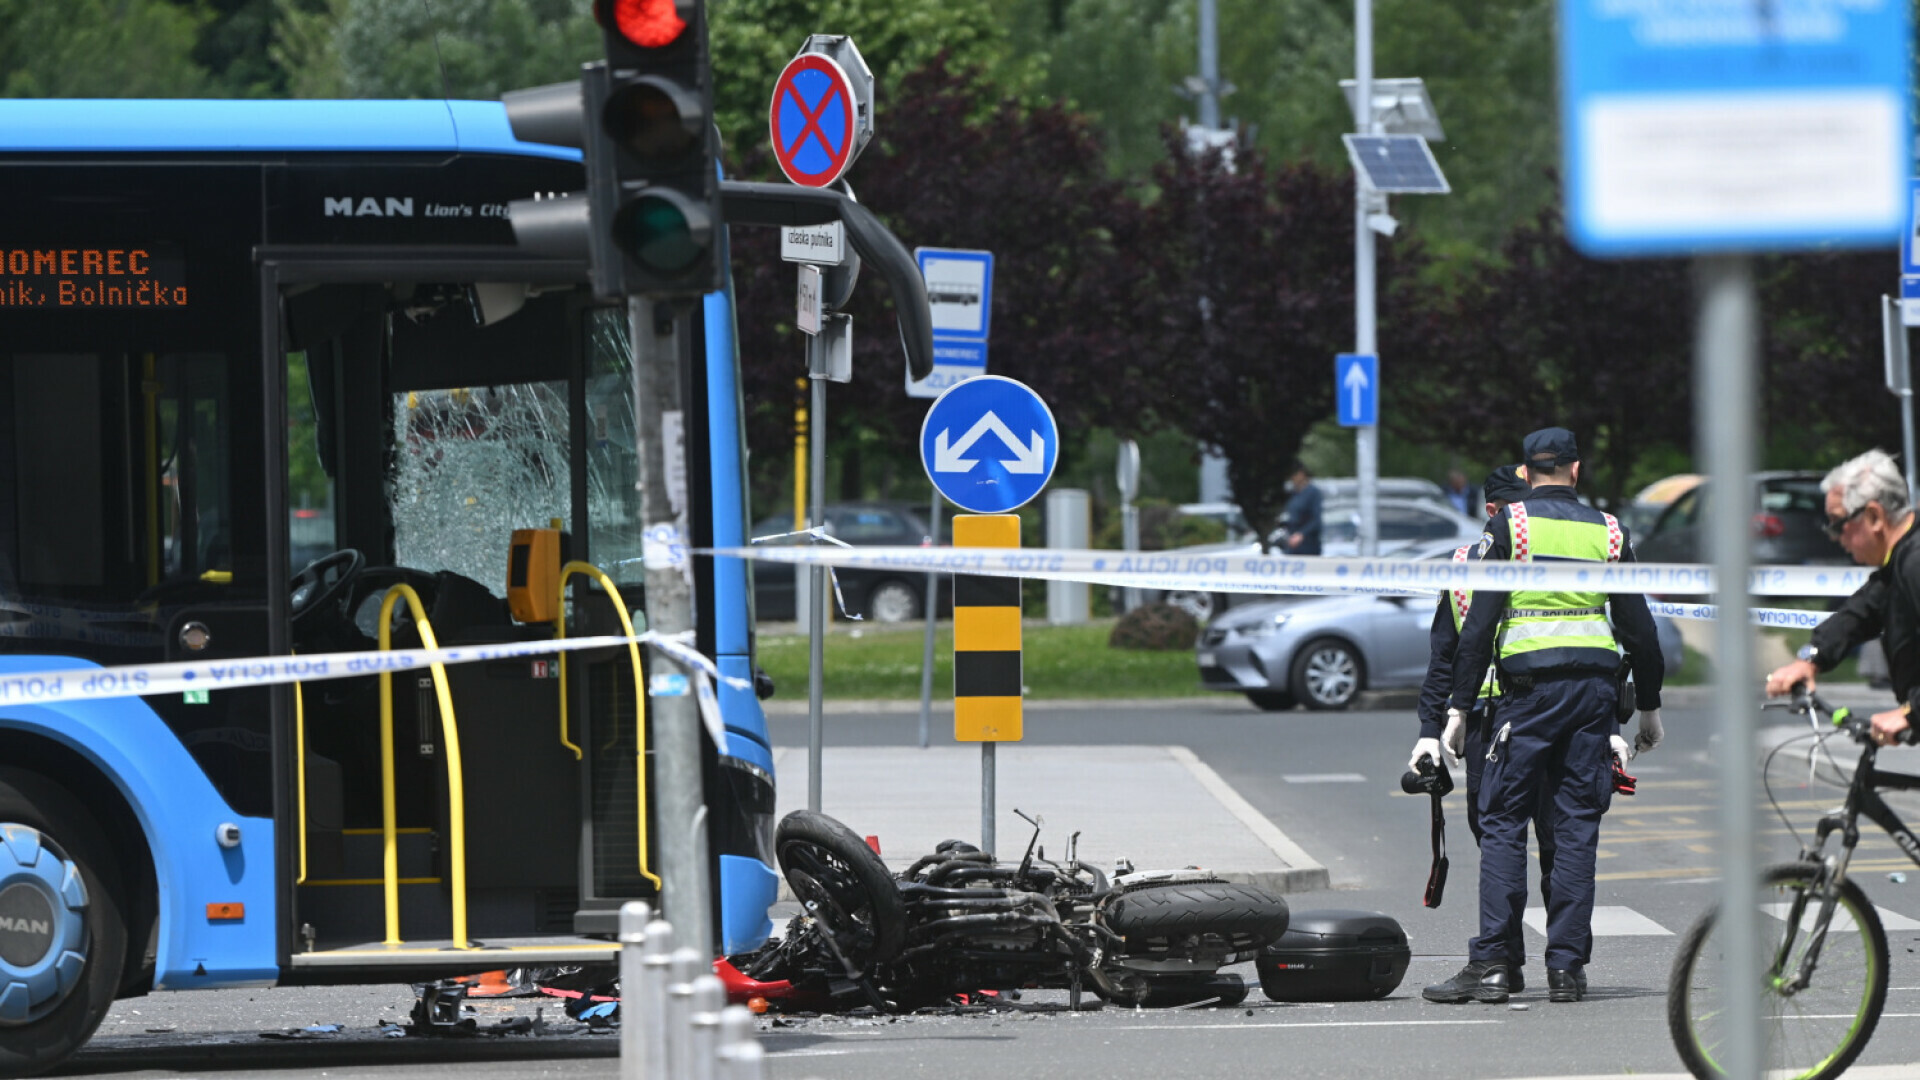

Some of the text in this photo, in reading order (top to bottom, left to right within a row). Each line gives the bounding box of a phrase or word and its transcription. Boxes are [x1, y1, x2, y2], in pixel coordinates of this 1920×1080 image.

[324, 197, 414, 217] MAN
[424, 203, 473, 217] Lion's
[0, 250, 150, 275] OMEREC
[58, 280, 188, 306] Bolnička
[1692, 606, 1718, 619] TOP
[1758, 609, 1818, 627] POLICIJA
[82, 669, 149, 692] STOP
[210, 660, 330, 683] POLICIJA
[0, 676, 63, 699] POLI
[0, 916, 49, 935] MAN
